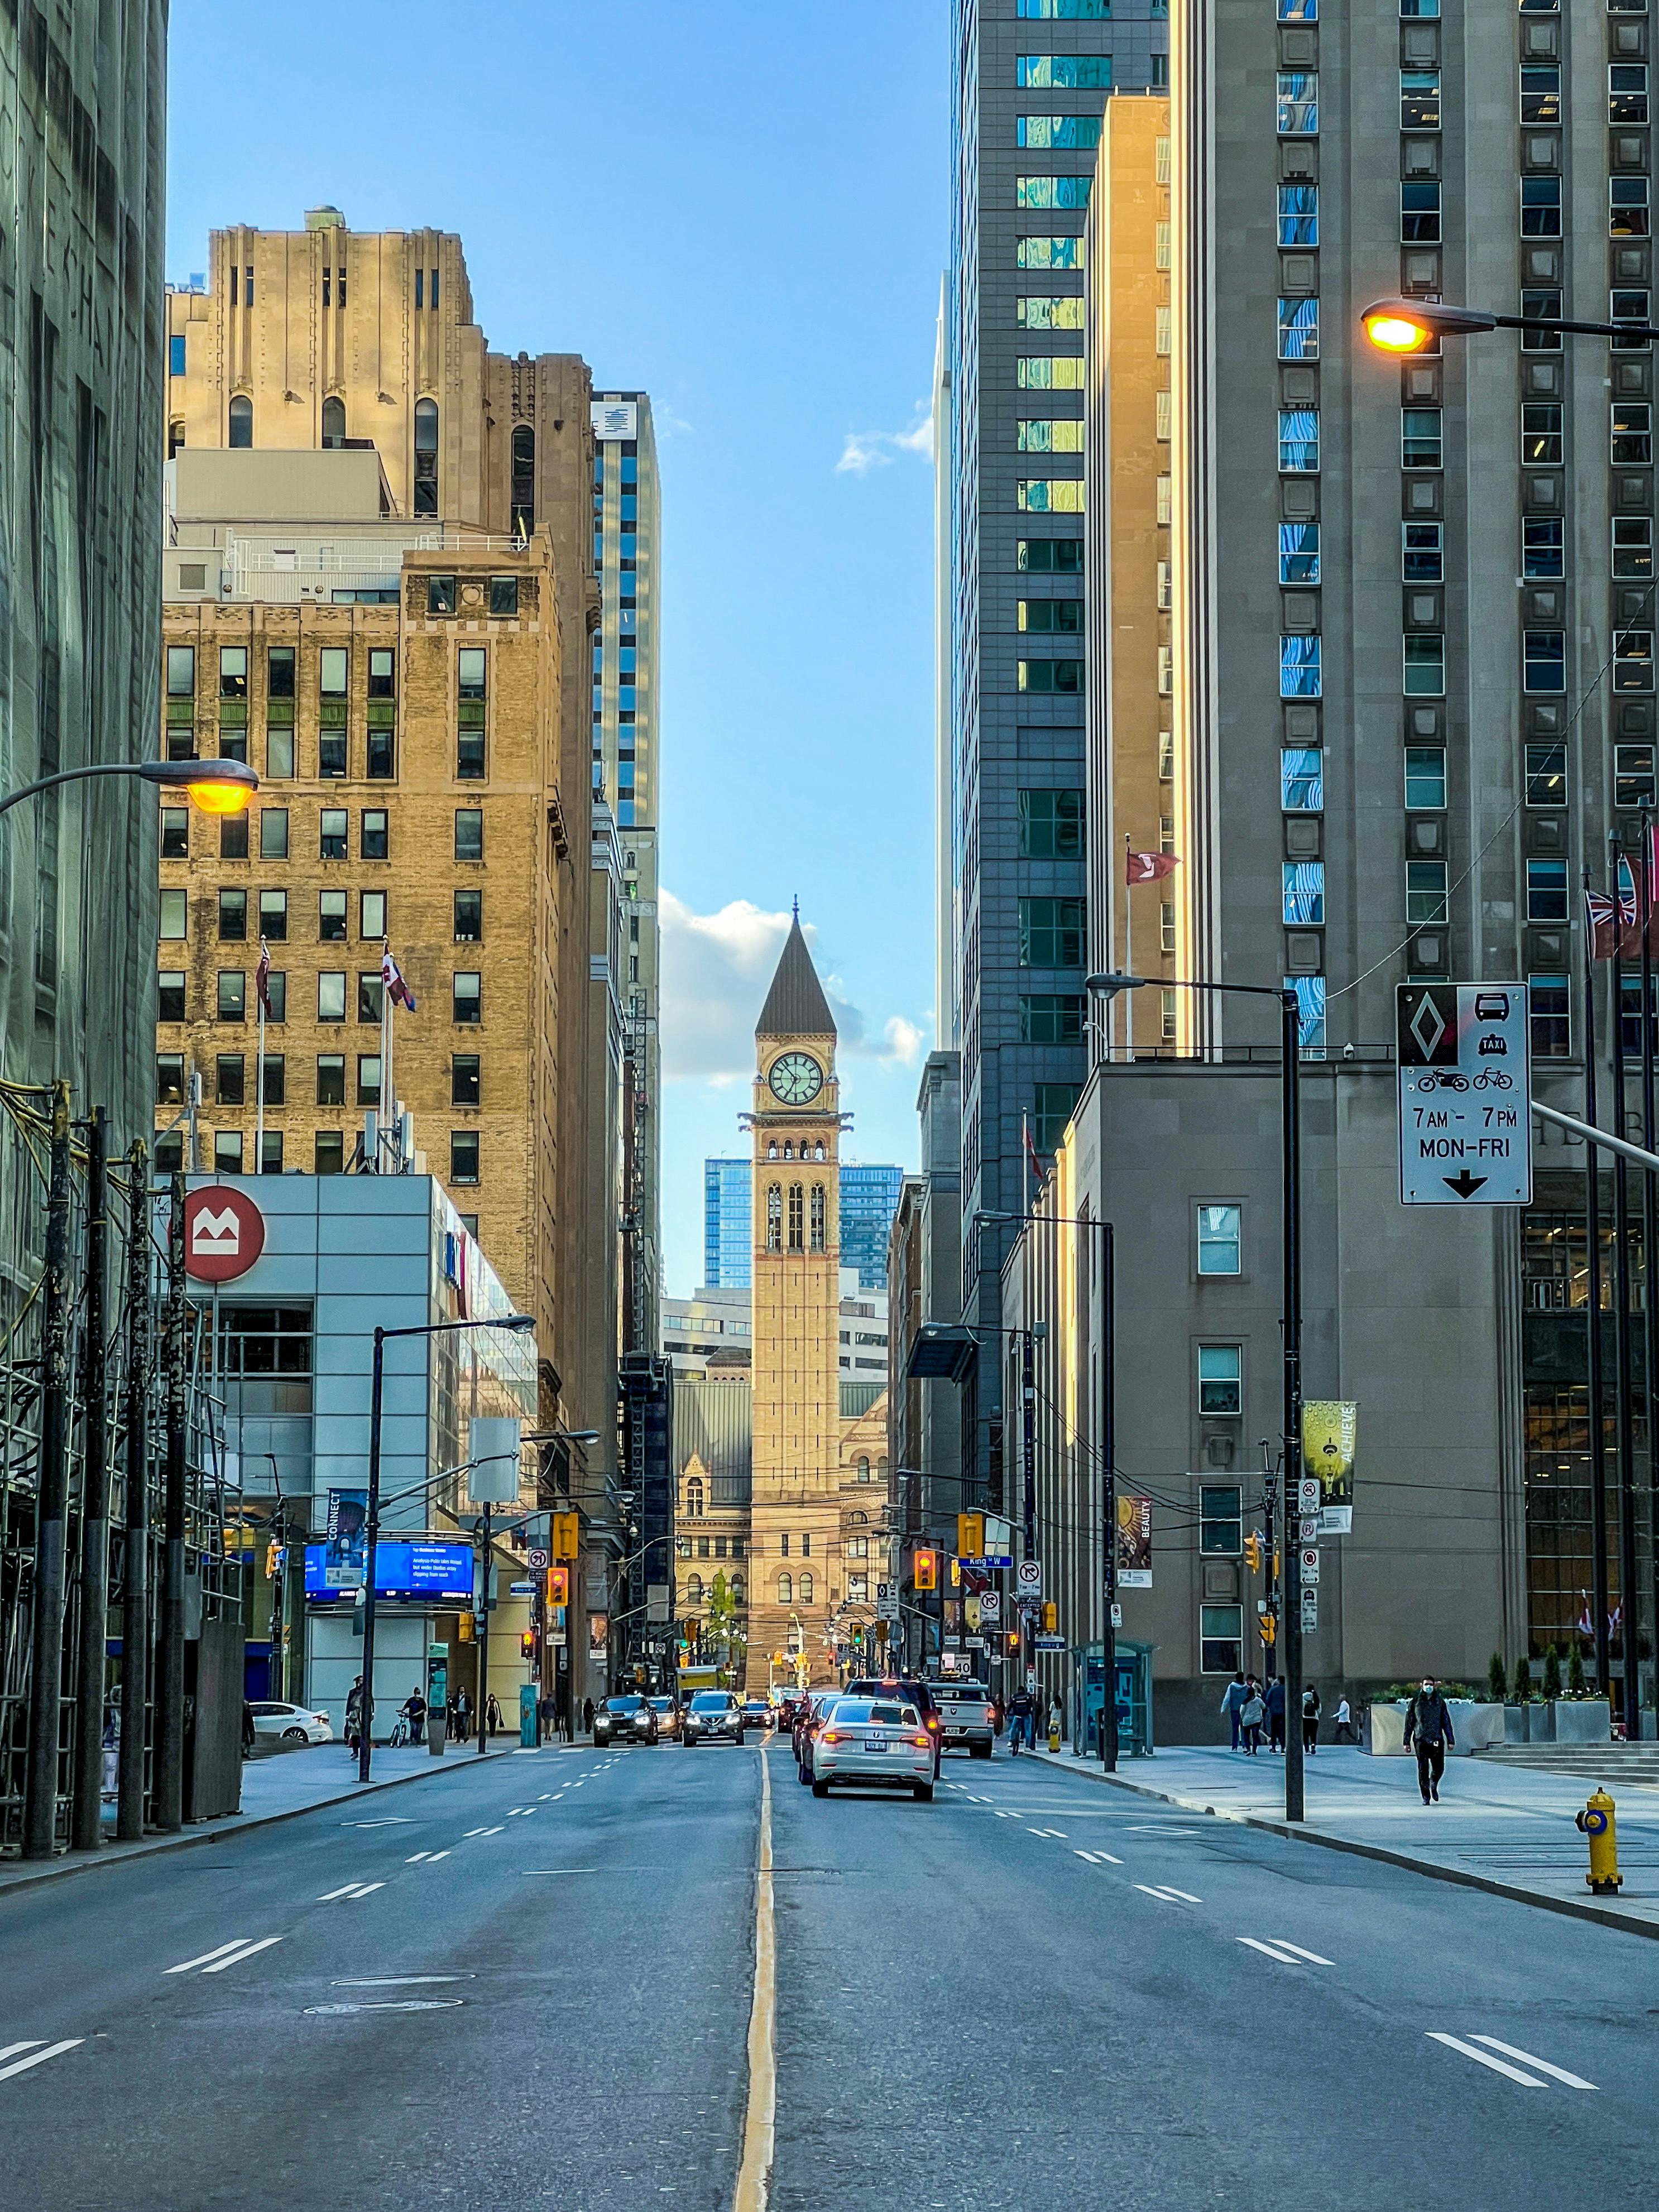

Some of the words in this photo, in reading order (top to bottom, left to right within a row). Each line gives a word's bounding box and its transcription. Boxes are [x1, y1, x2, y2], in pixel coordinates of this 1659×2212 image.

[1483, 1040, 1503, 1049] TAXI
[1420, 1138, 1509, 1158] MON-FRI
[329, 1492, 340, 1540] CONNECT
[970, 1558, 986, 1567] King
[955, 1663, 970, 1673] 40
